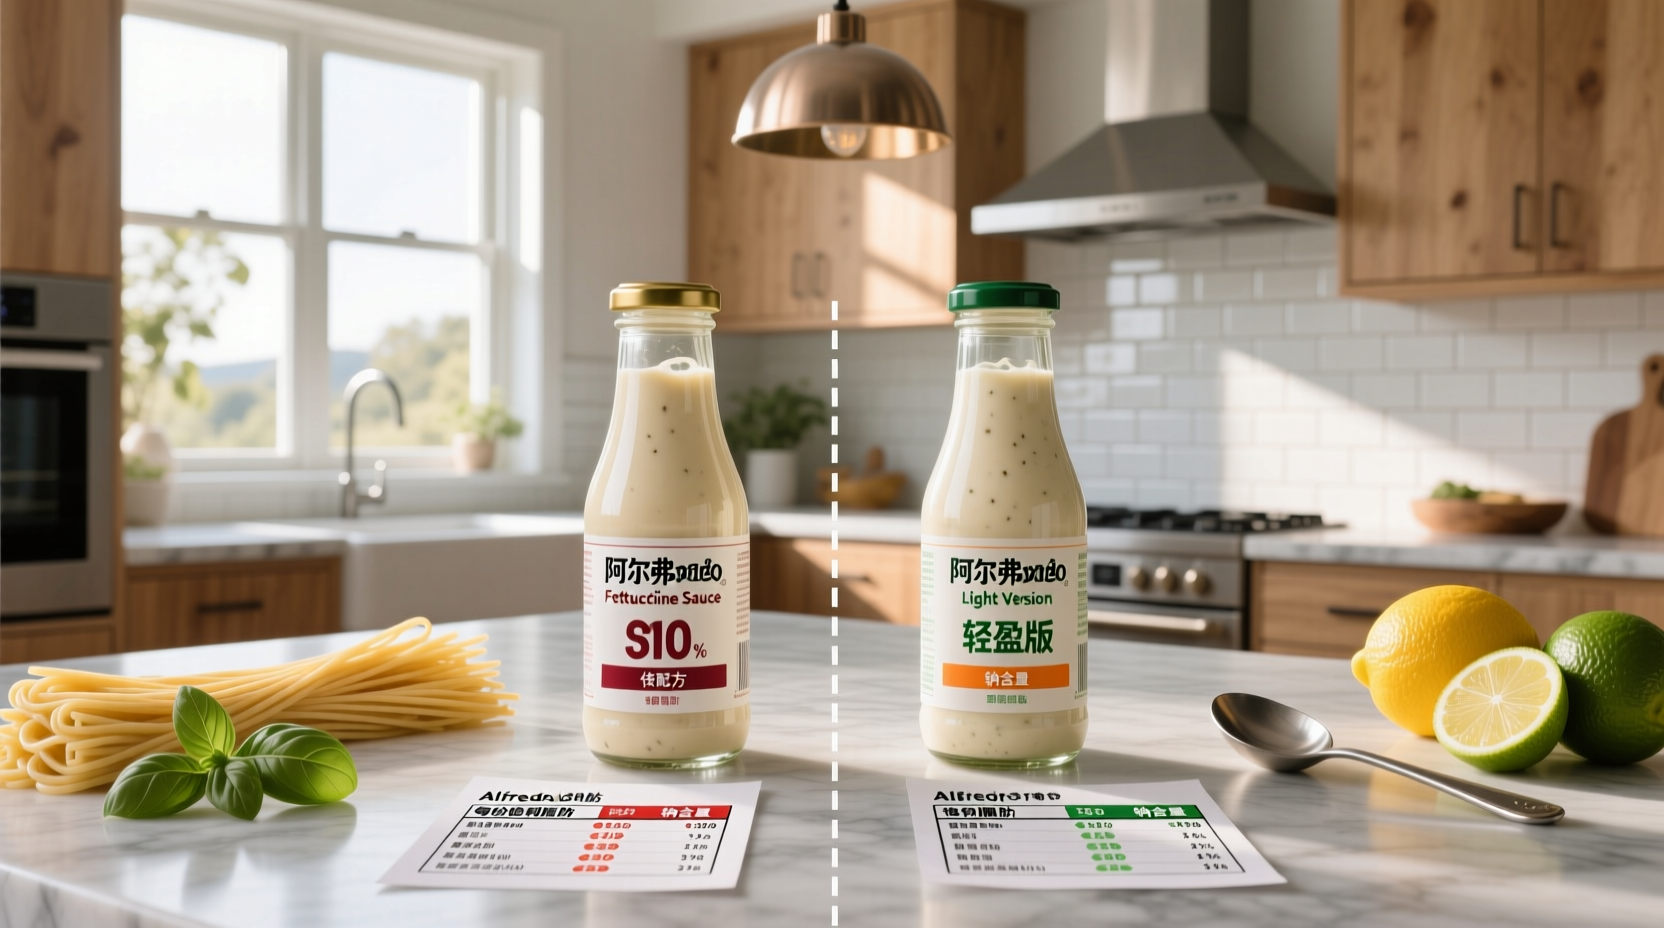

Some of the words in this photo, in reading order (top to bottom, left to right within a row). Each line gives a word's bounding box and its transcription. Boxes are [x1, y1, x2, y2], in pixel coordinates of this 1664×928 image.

[682, 591, 722, 605] Sauce
[962, 590, 998, 609] Light
[1001, 591, 1053, 606] Version
[962, 619, 1053, 654] 轻盈版
